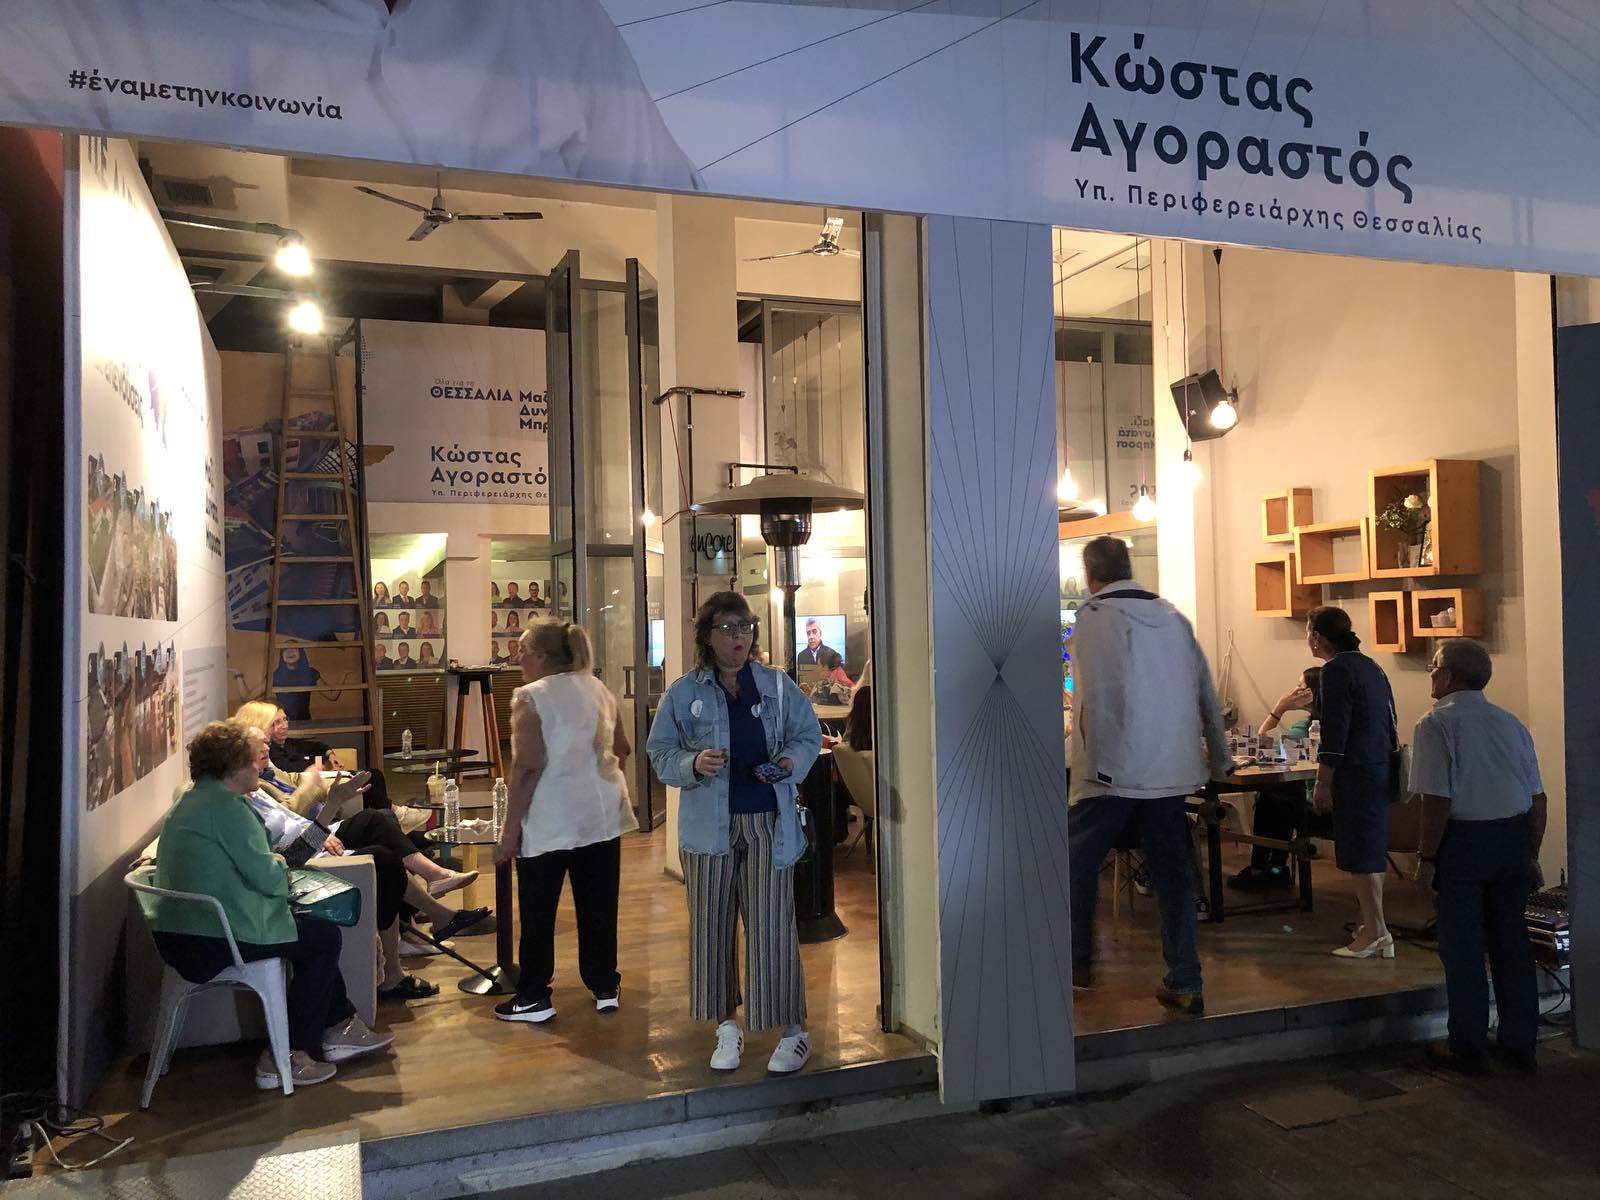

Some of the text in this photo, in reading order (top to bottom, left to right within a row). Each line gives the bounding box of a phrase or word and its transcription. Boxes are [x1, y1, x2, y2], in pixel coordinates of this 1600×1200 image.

[1070, 32, 1313, 128] Κώστας
[69, 69, 342, 120] #έναμετηνκοινωνία
[1070, 102, 1413, 204] Αγοραστός
[1075, 178, 1482, 244] Υπ. Περιφερειάρχης Θεσσαλίας
[430, 385, 513, 402] ΘΕΣΣΑΛΙΑ
[519, 390, 548, 403] Μαζ
[519, 404, 548, 416] Δυν
[519, 417, 548, 433] Μπρ
[430, 444, 522, 468] Κώστας
[430, 466, 548, 487] Αγοραστό
[450, 489, 533, 500] Περιφερειάρχης
